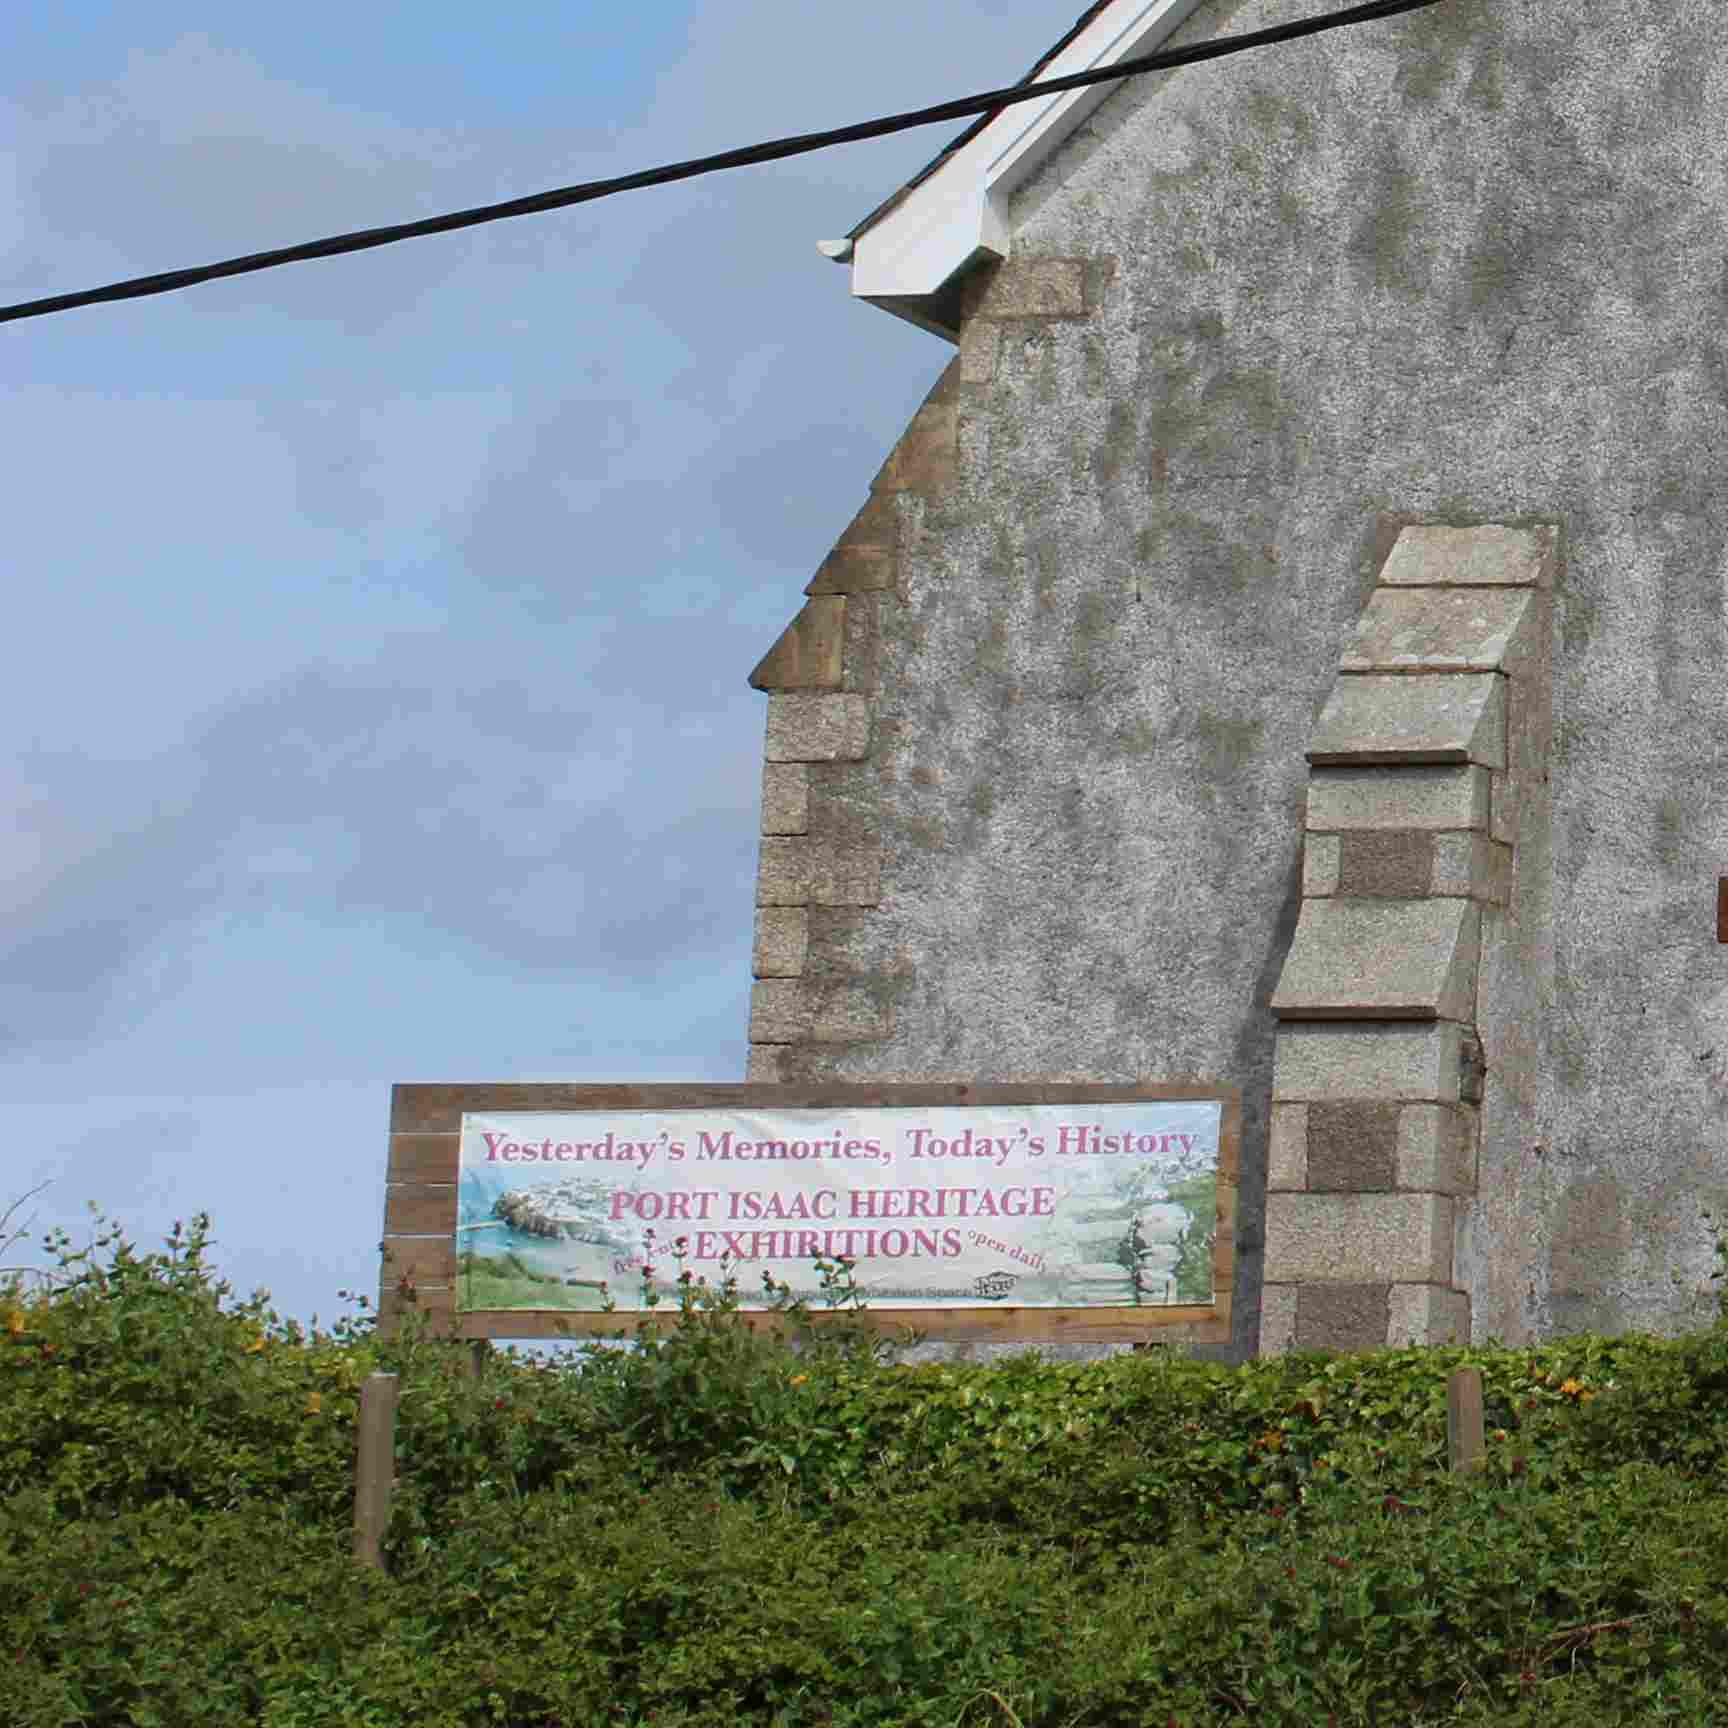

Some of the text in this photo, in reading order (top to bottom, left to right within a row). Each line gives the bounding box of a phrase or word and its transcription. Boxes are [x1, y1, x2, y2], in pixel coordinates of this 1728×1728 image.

[481, 1124, 1199, 1171] Yesterday's Memories, Today's History
[608, 1186, 1056, 1221] PORT ISAAC HERITAGE
[695, 1228, 962, 1260] EXHIBITIONS
